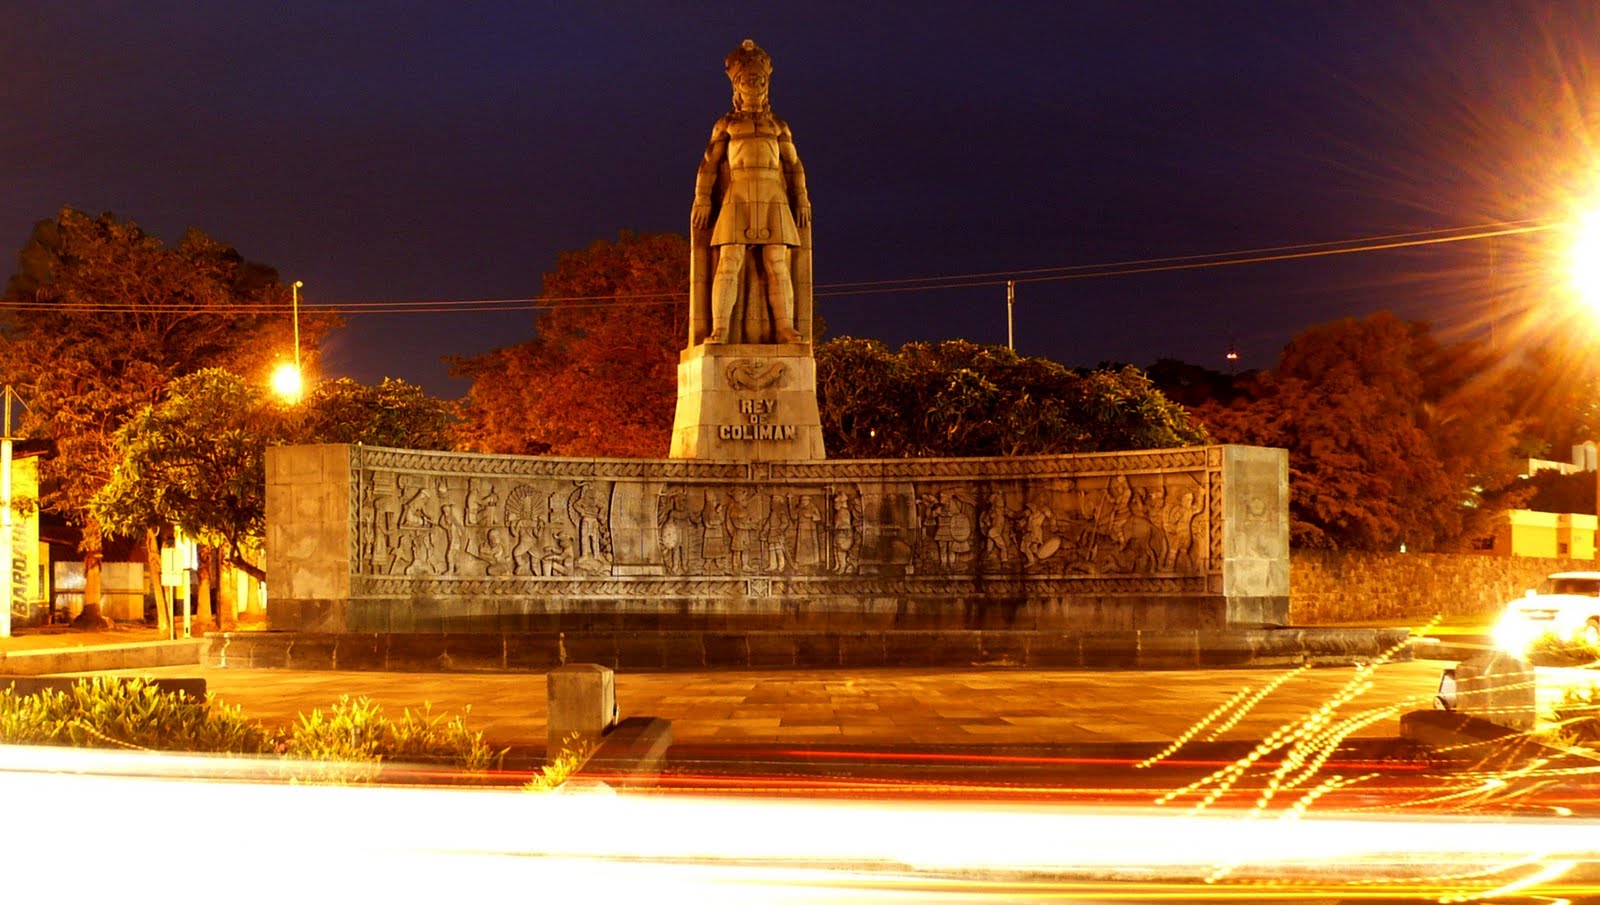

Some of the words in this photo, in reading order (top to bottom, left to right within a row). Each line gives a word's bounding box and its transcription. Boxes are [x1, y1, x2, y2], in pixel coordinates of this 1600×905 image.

[741, 399, 775, 414] REY
[750, 414, 767, 425] DE
[719, 425, 796, 440] COLIMAN
